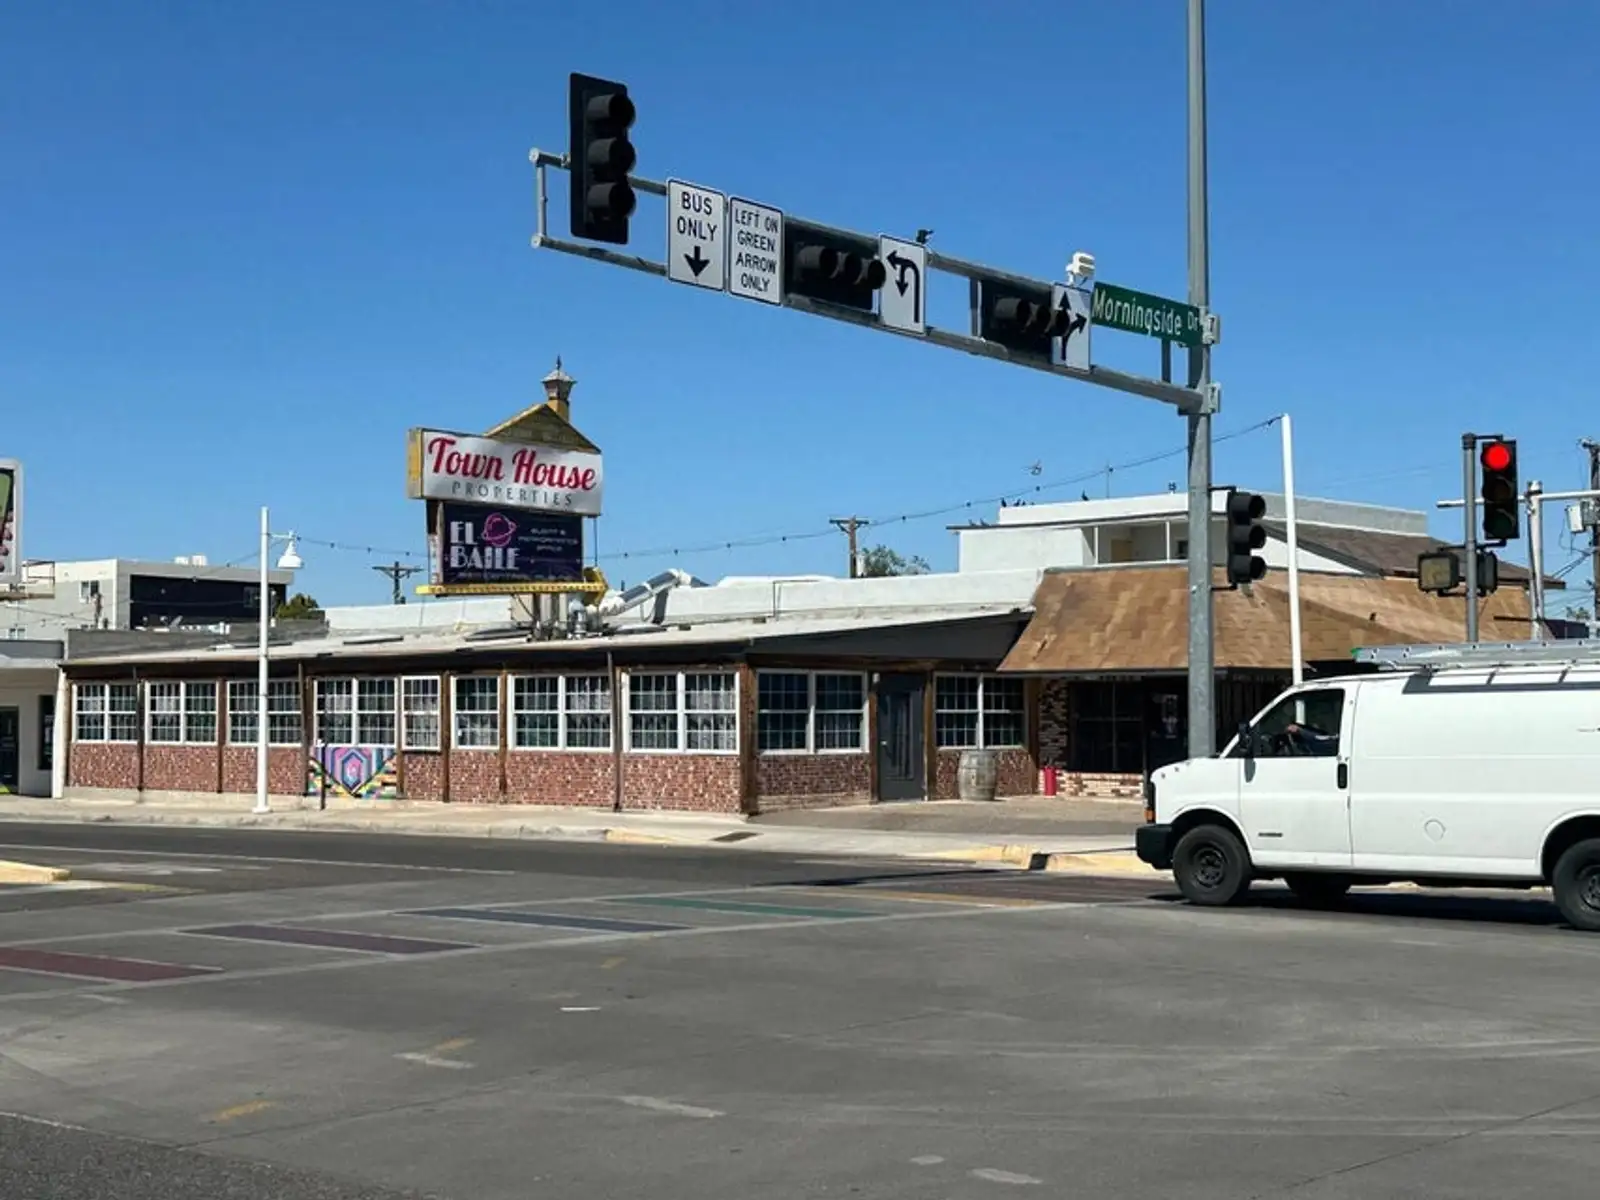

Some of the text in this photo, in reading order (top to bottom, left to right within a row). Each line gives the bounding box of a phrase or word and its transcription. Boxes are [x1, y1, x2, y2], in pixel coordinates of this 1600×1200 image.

[681, 191, 712, 216] BUS
[677, 216, 717, 241] ONLY
[735, 208, 779, 233] LEFT ON
[737, 230, 776, 253] GREEN
[736, 252, 778, 274] ARROW
[740, 273, 770, 293] ONLY
[1091, 287, 1199, 337] Morningside Dr
[427, 436, 597, 491] Town House
[451, 480, 573, 507] PROPERTIES
[450, 520, 478, 546] EL
[450, 545, 521, 571] BAILE
